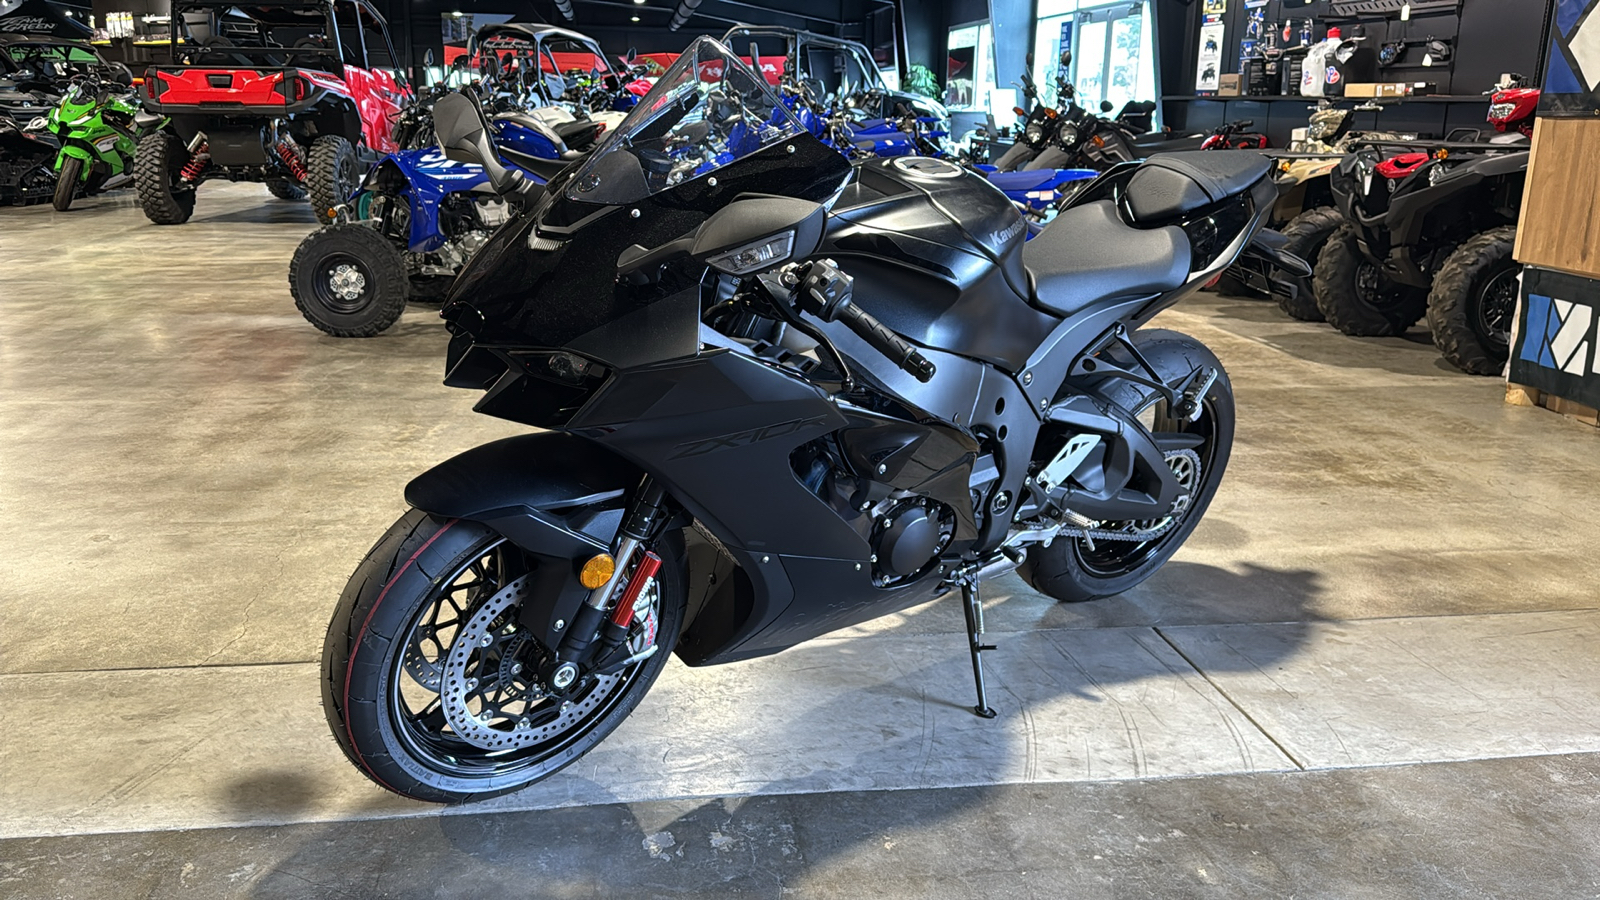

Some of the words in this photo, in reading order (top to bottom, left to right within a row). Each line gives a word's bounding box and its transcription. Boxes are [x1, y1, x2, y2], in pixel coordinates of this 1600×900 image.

[2, 20, 56, 32] GREEN
[989, 217, 1025, 247] Kawas
[632, 575, 654, 612] SHOWA
